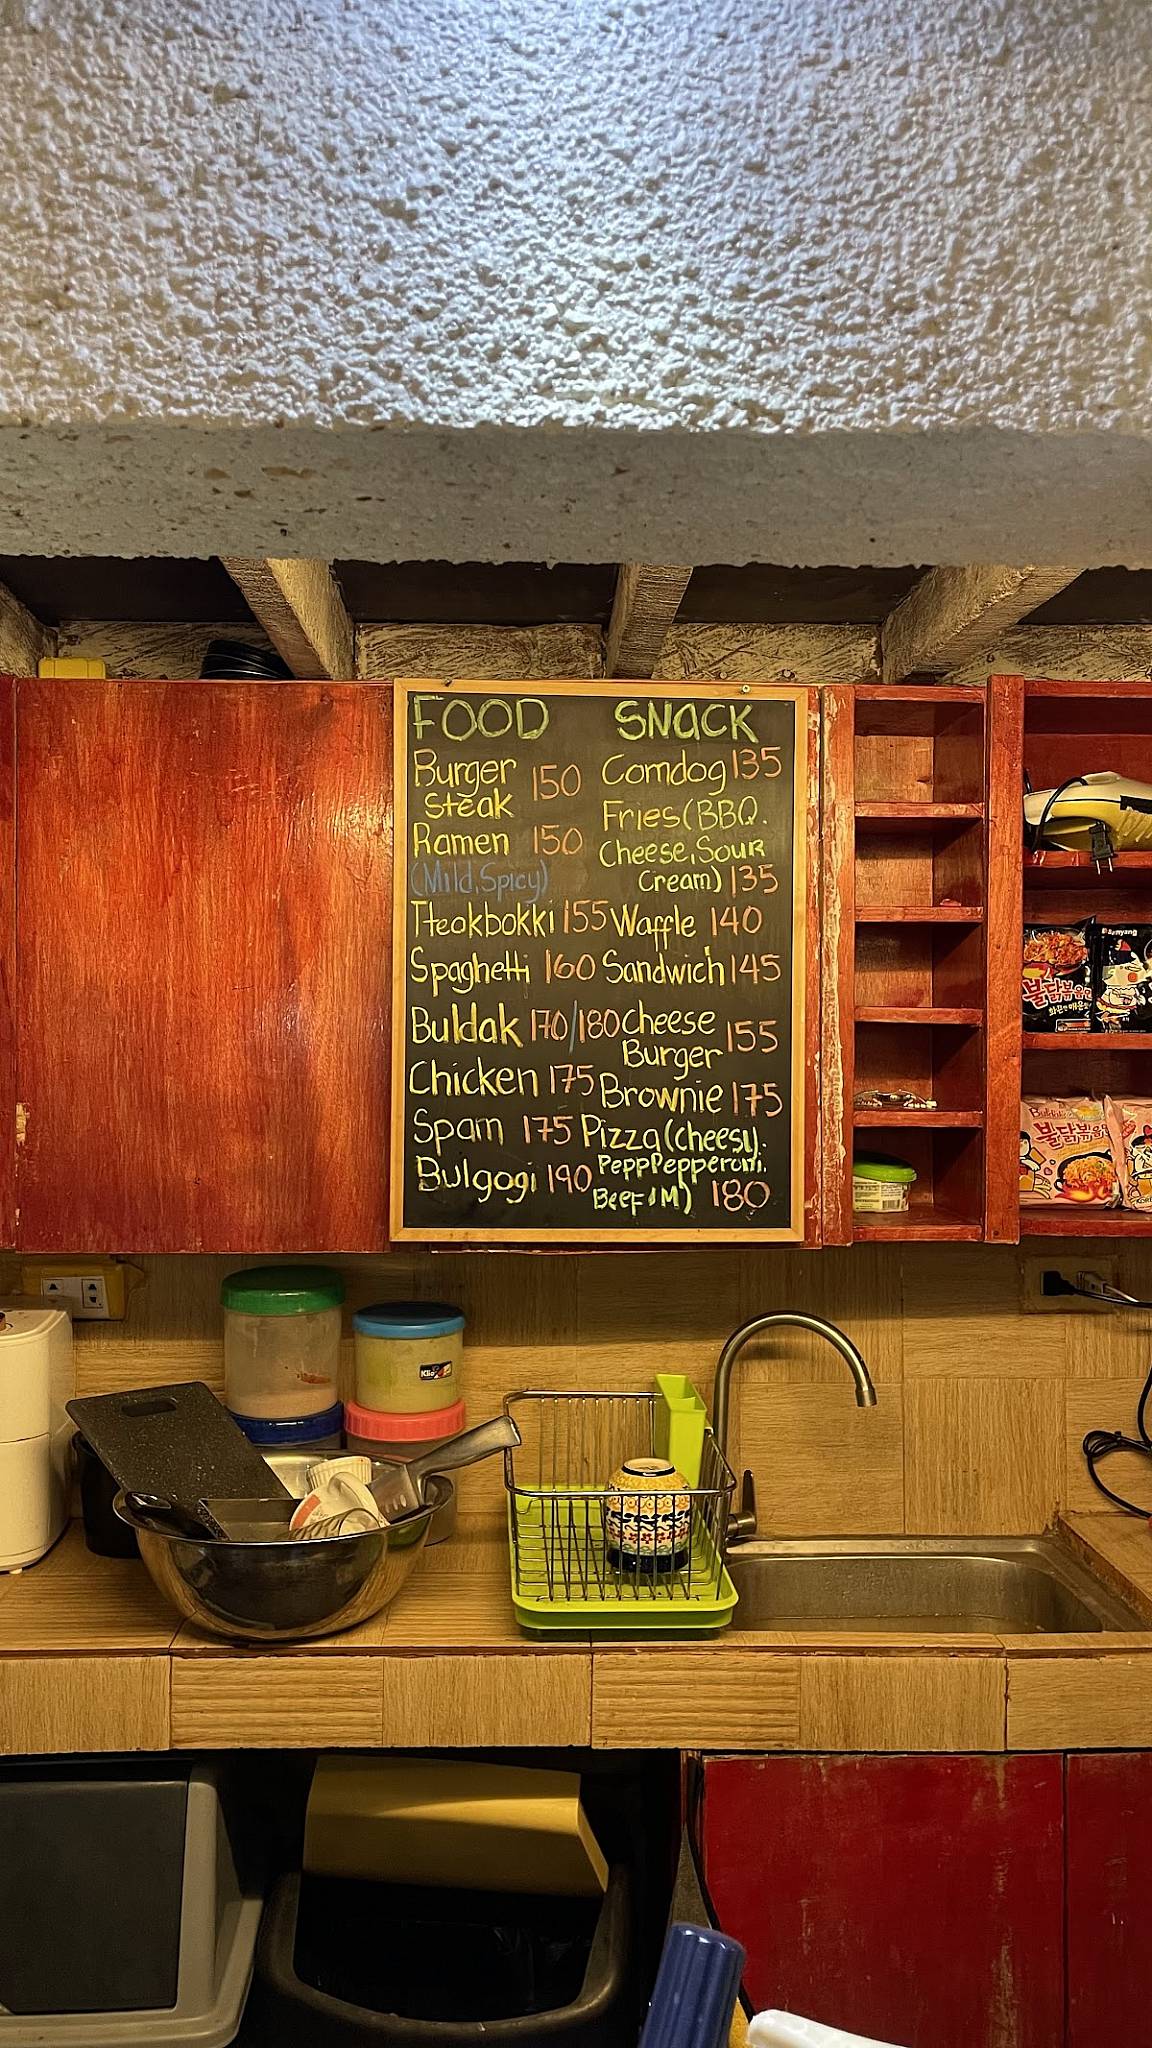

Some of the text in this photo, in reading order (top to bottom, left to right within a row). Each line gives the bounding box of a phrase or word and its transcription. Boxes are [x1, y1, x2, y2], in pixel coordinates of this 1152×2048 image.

[413, 695, 549, 741] FOOD
[413, 748, 581, 801] Burger 150
[732, 746, 782, 780] 135
[413, 822, 583, 858] Ramen 150
[731, 864, 779, 898] 135
[564, 899, 609, 934] 155
[609, 903, 763, 952] Waffle 140
[410, 946, 597, 998] Spaghetti 160
[602, 945, 782, 986] Sandwich 145
[411, 1001, 524, 1048] Buldak
[726, 1020, 779, 1053] 155
[409, 1056, 595, 1098] Chicken 175
[621, 1038, 724, 1082] Burger
[600, 1072, 783, 1118] Brownie 175
[413, 1108, 574, 1157] Spam 175
[415, 1155, 593, 1204] Bulgogi 190
[712, 1178, 771, 1212] 180
